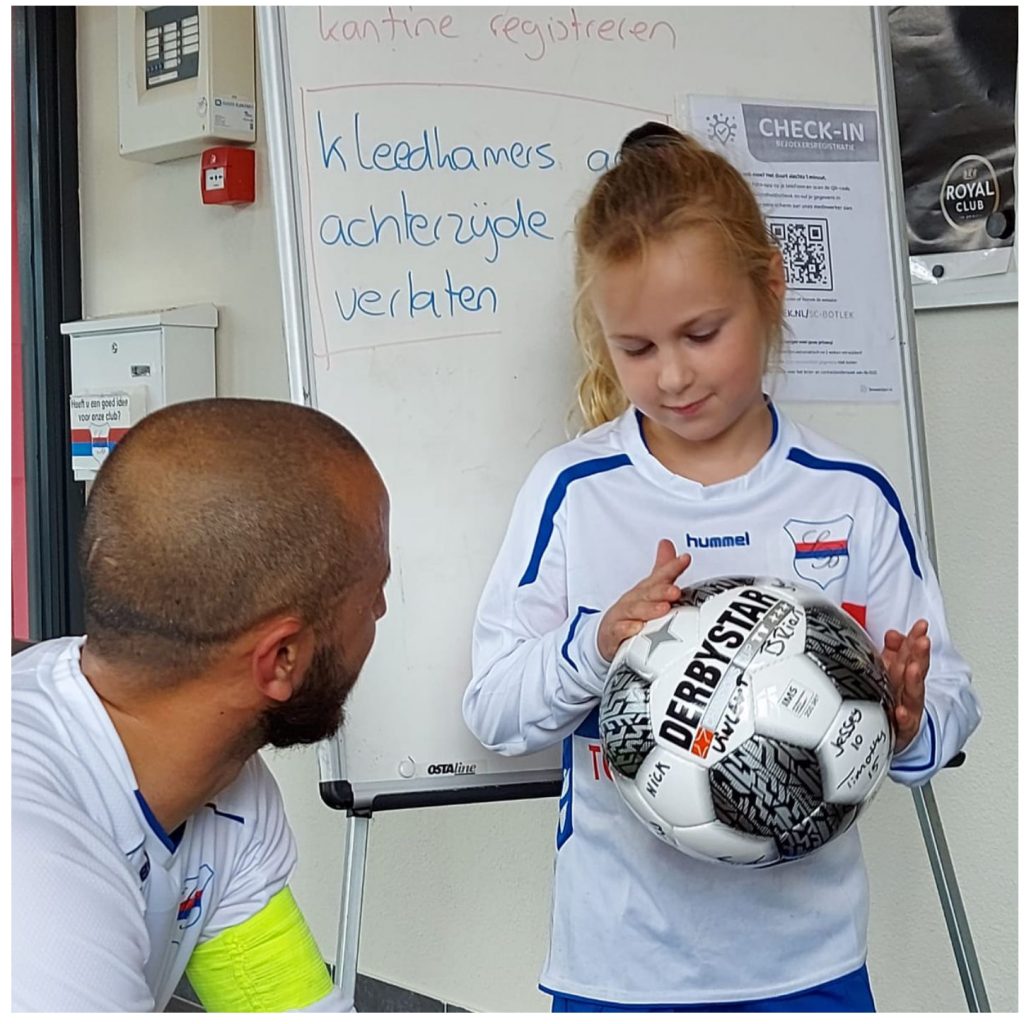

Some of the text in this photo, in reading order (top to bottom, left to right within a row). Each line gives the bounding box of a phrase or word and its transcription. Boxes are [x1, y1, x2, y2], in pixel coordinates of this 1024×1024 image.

[318, 6, 460, 43] kantine
[759, 117, 865, 143] CHECK-IN
[945, 180, 996, 201] ROYAL
[955, 199, 985, 213] CLUB
[686, 532, 750, 548] hummel
[658, 589, 780, 752] DERBYSTAR
[850, 734, 864, 751] 10
